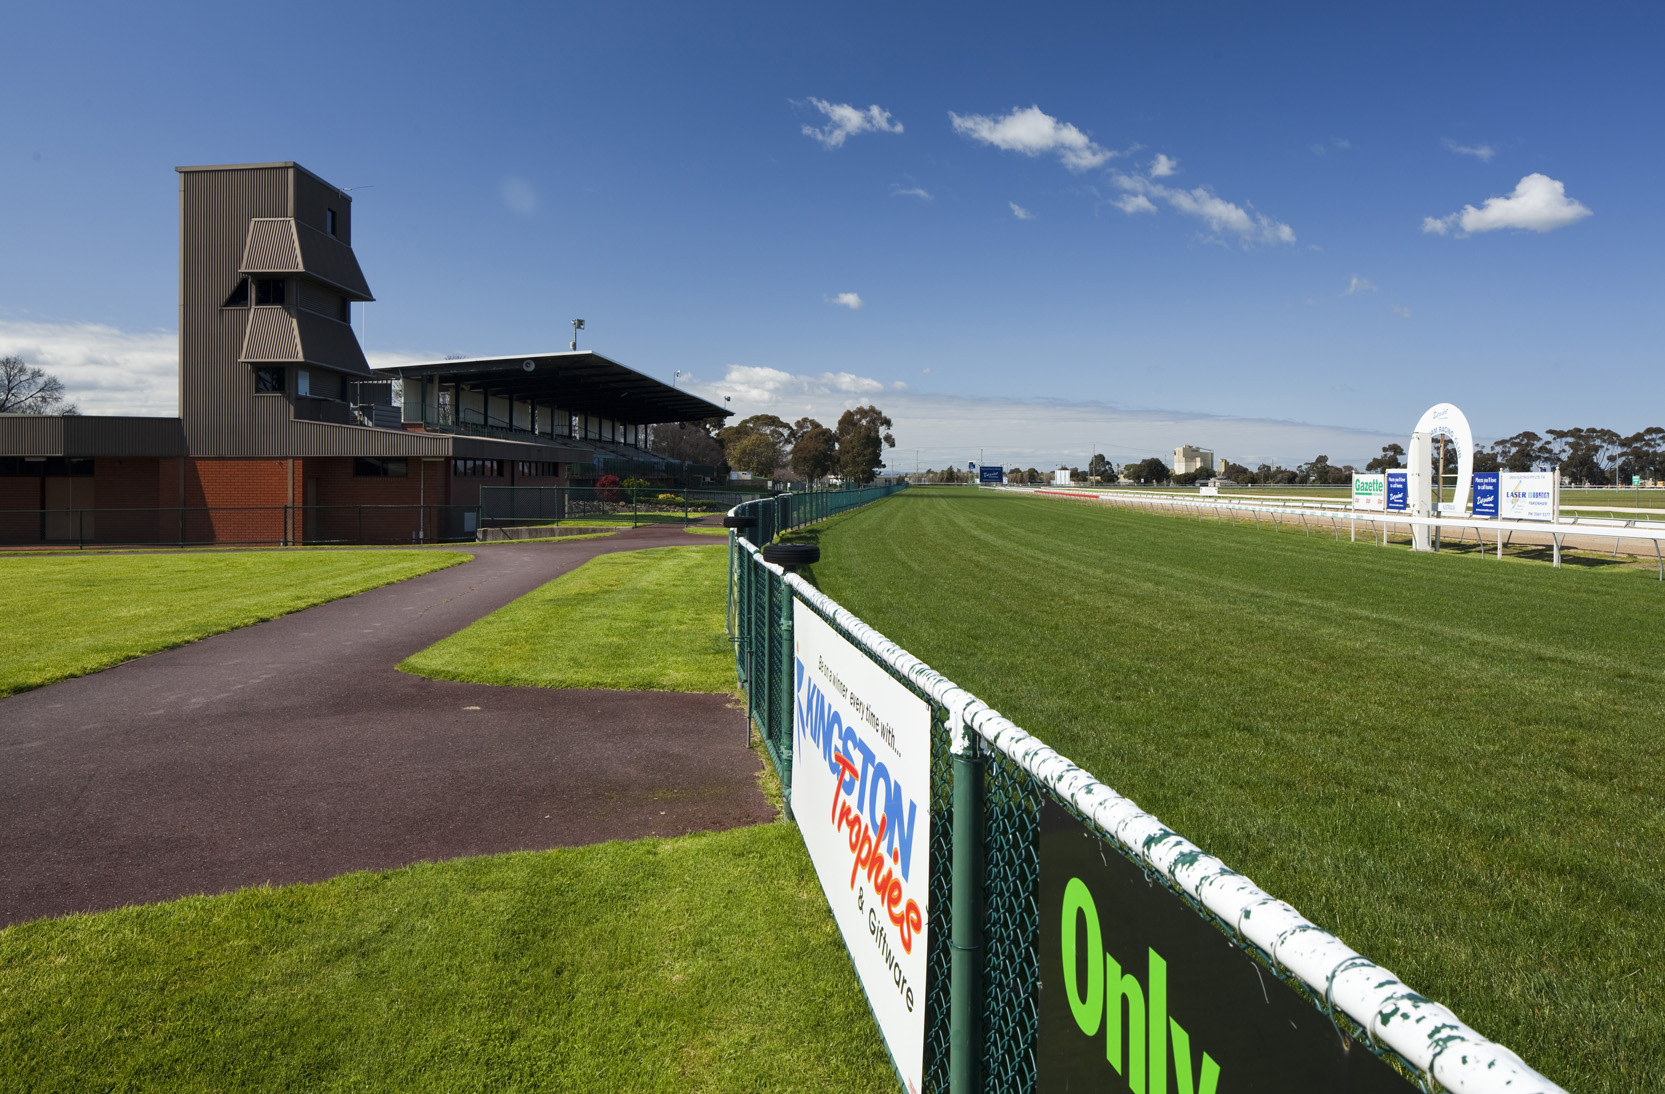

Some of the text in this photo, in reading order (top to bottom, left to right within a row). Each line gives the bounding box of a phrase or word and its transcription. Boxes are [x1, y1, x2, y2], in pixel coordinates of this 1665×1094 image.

[1355, 478, 1383, 492] Gazette
[1477, 495, 1494, 505] Devine
[819, 655, 824, 672] Be
[832, 673, 848, 699] winner
[850, 692, 866, 720] every
[865, 704, 879, 733] time
[881, 721, 901, 758] with...
[806, 675, 917, 883] KINGSTON
[832, 751, 921, 955] Trophies
[858, 886, 914, 1013] & Giftware
